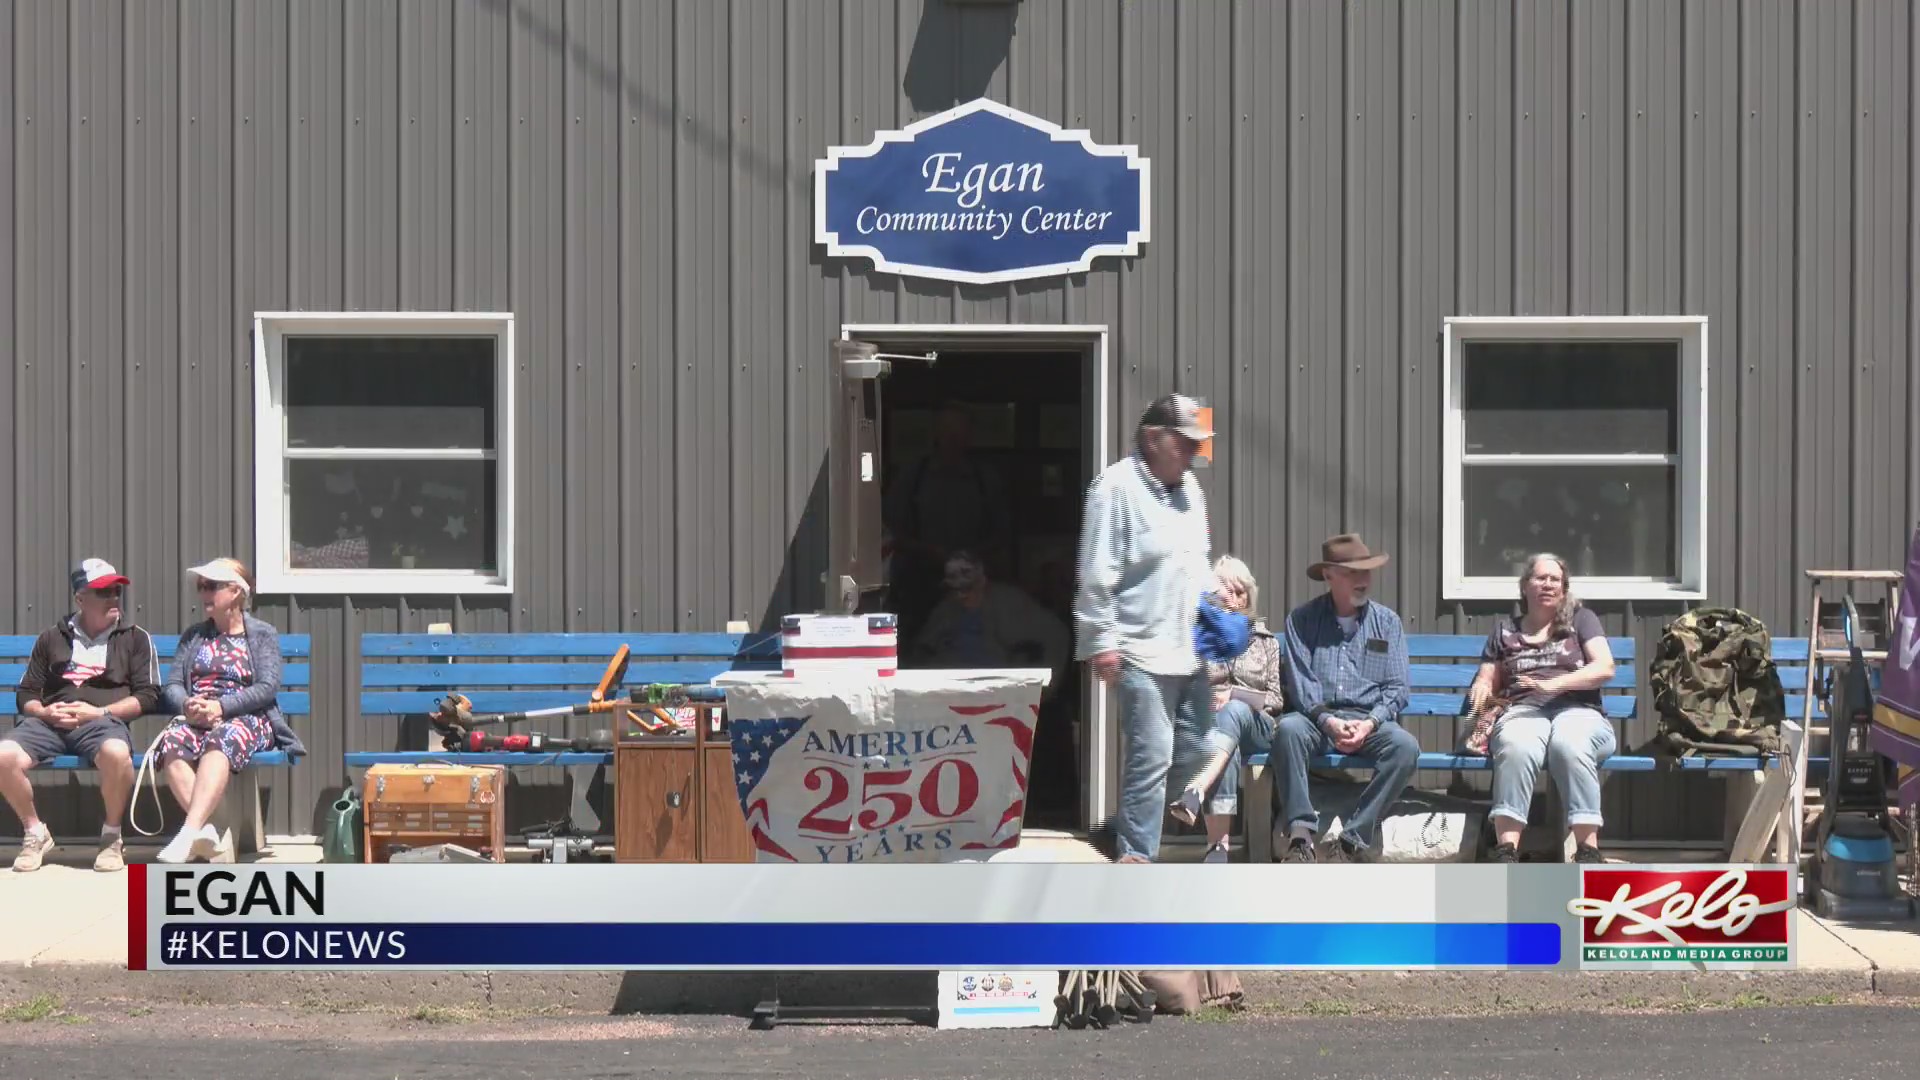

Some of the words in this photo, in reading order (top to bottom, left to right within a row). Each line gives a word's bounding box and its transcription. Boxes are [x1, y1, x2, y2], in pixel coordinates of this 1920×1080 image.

[922, 152, 1045, 208] Egan
[856, 205, 1013, 240] Community
[1021, 205, 1112, 234] Center
[803, 723, 976, 757] AMERICA
[798, 758, 979, 835] 250
[815, 828, 953, 863] YEARS
